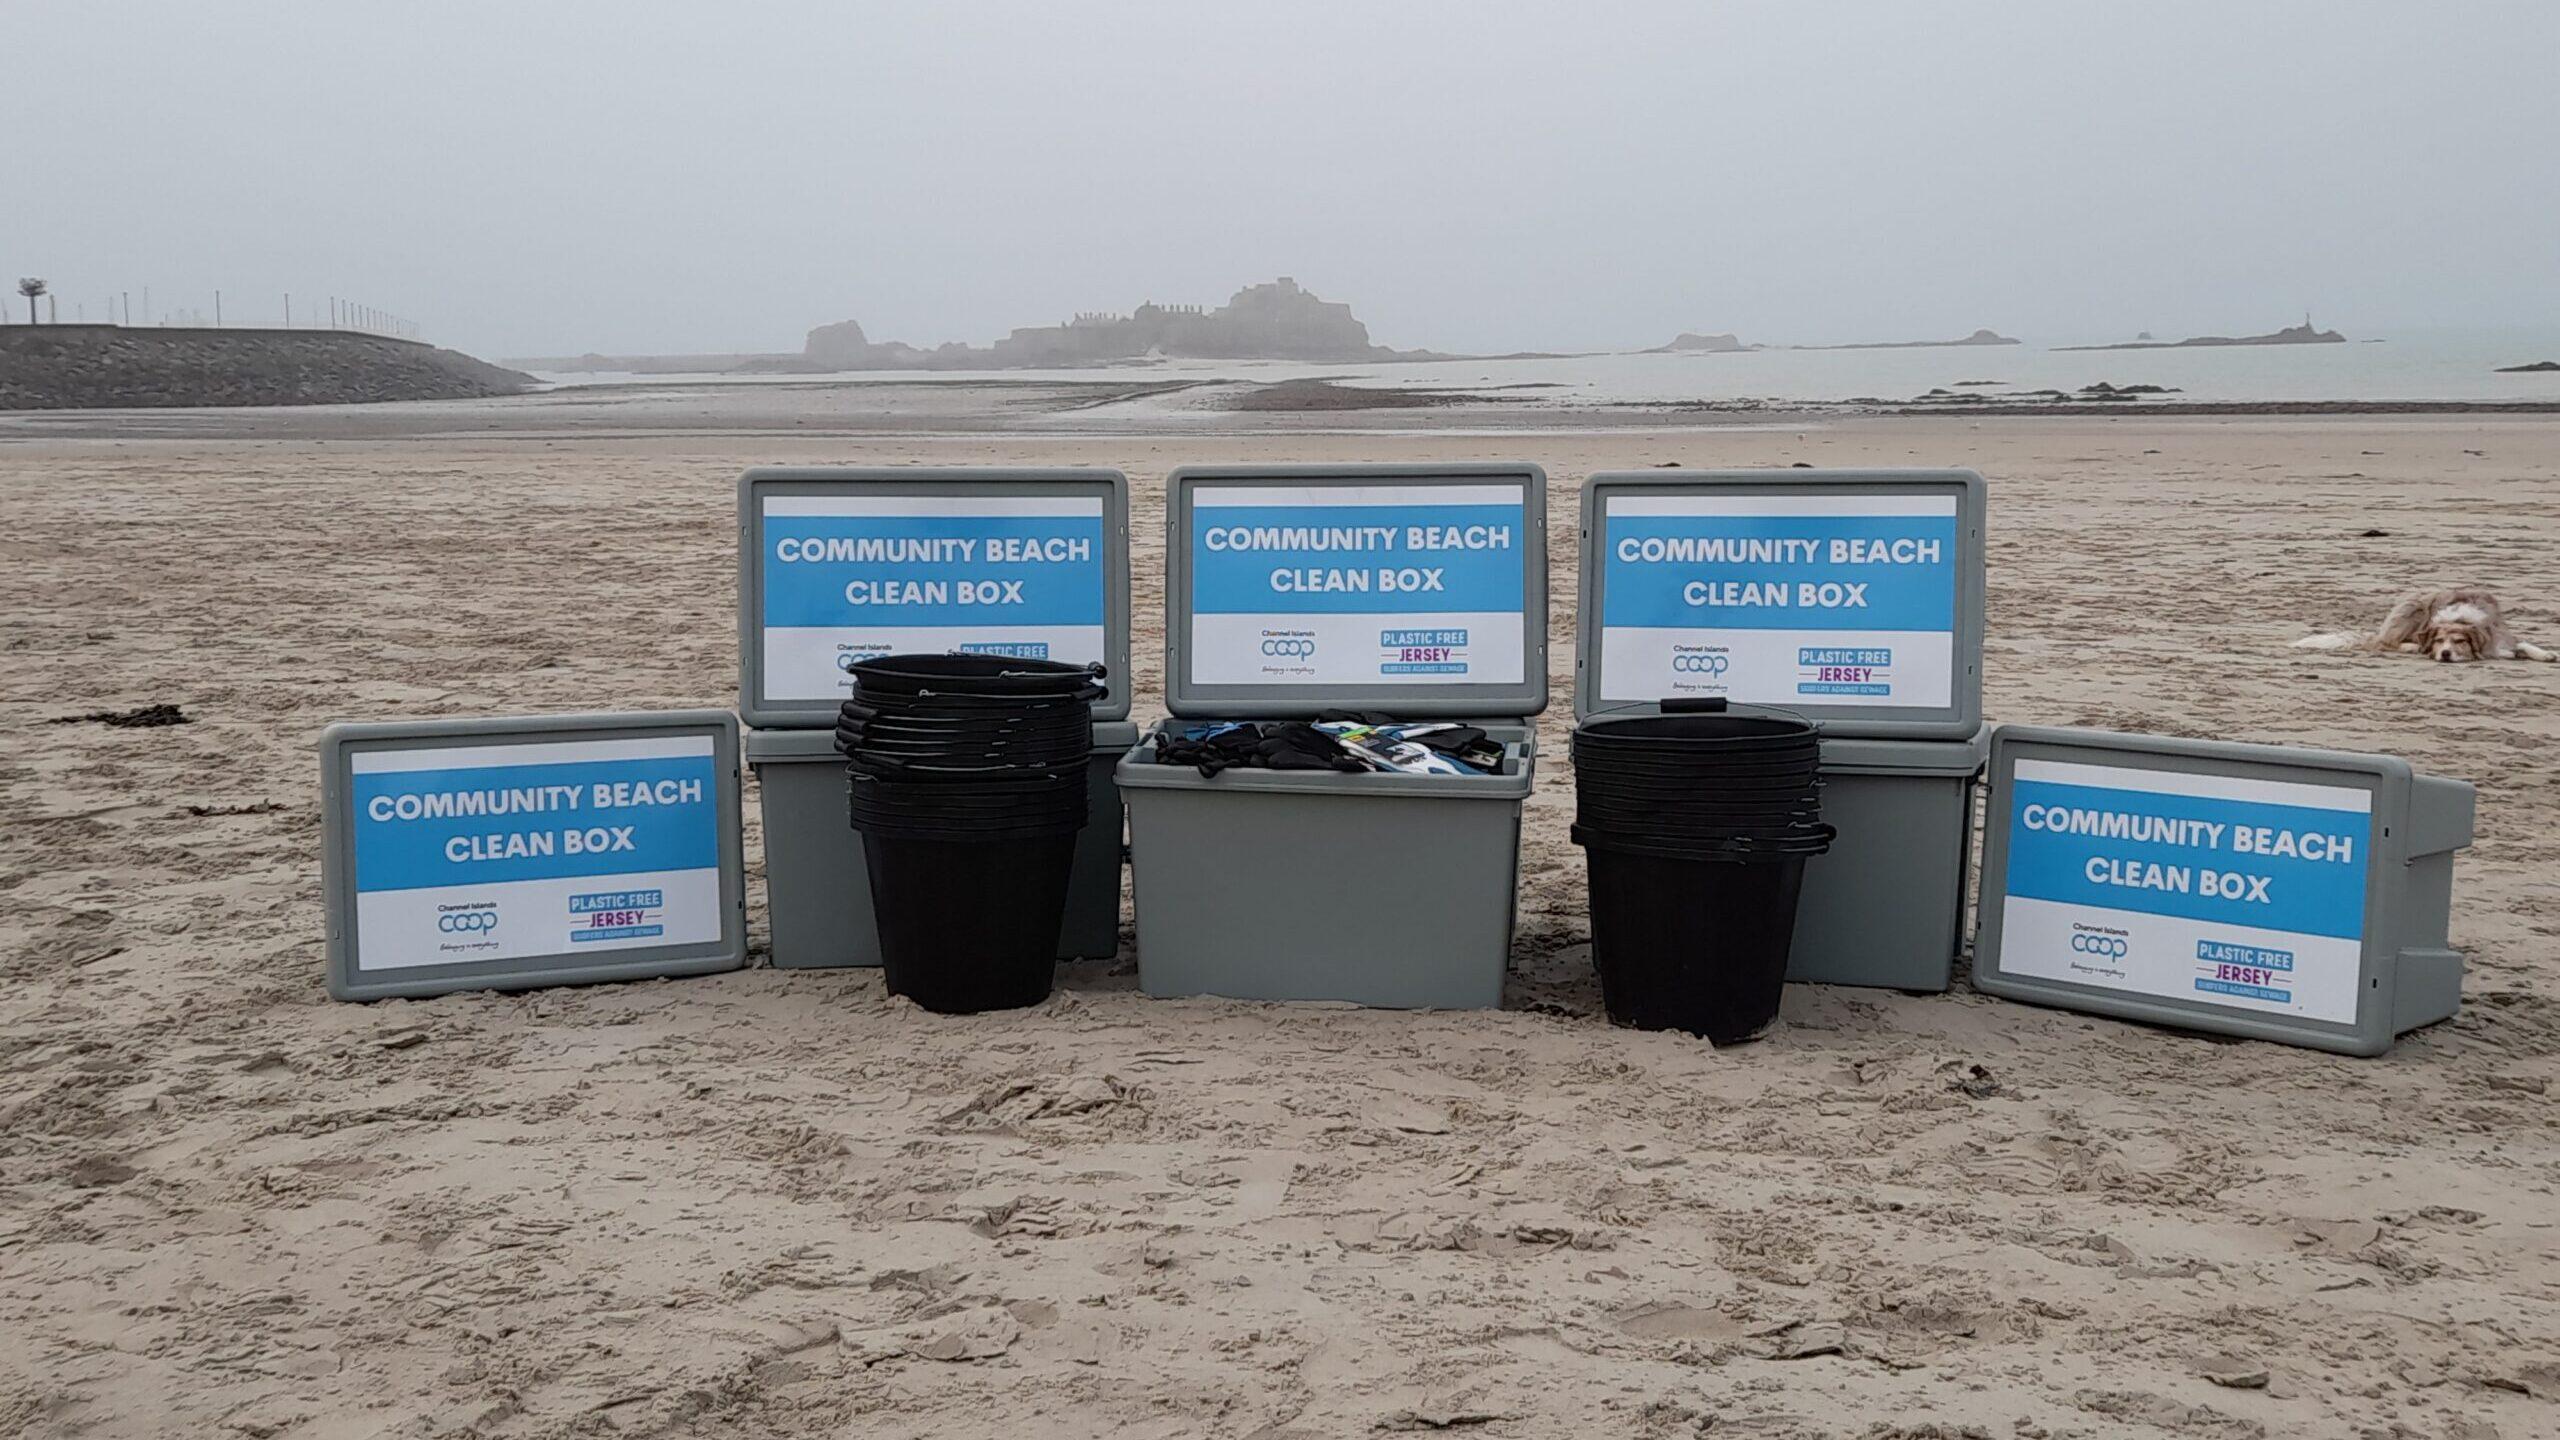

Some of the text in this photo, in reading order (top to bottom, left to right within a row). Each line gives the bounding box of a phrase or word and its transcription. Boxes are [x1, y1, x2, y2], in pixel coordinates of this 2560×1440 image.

[1204, 525, 1510, 551] COMMUNITY BEACH
[775, 537, 1091, 564] COMMUNITY BEACH
[1616, 537, 1941, 564] COMMUNITY BEACH
[1269, 567, 1445, 593] CLEAN BOX
[844, 580, 1025, 606] CLEAN BOX
[1683, 581, 1869, 608] CLEAN BOX
[1261, 629, 1291, 637] Channel
[1383, 631, 1465, 645] PLASTIC FREE
[837, 642, 867, 651] Channel
[1016, 645, 1046, 658] FREE
[1399, 648, 1450, 662] JERSEY
[1673, 644, 1703, 652] Channel
[1801, 650, 1889, 664] PLASTIC FREE
[1818, 667, 1872, 682] JERSEY
[367, 778, 703, 823] COMMUNITY BEACH
[444, 825, 636, 863] CLEAN BOX
[2021, 803, 2355, 865] COMMUNITY BEACH
[2084, 856, 2273, 905] CLEAN BOX
[438, 902, 470, 912] Channel
[571, 892, 660, 911] PLASTIC FREE
[590, 910, 644, 928] JERSEY
[2072, 922, 2103, 932] Channel
[2199, 942, 2291, 969] PLASTIC FREE
[2215, 963, 2273, 986] JERSEY
